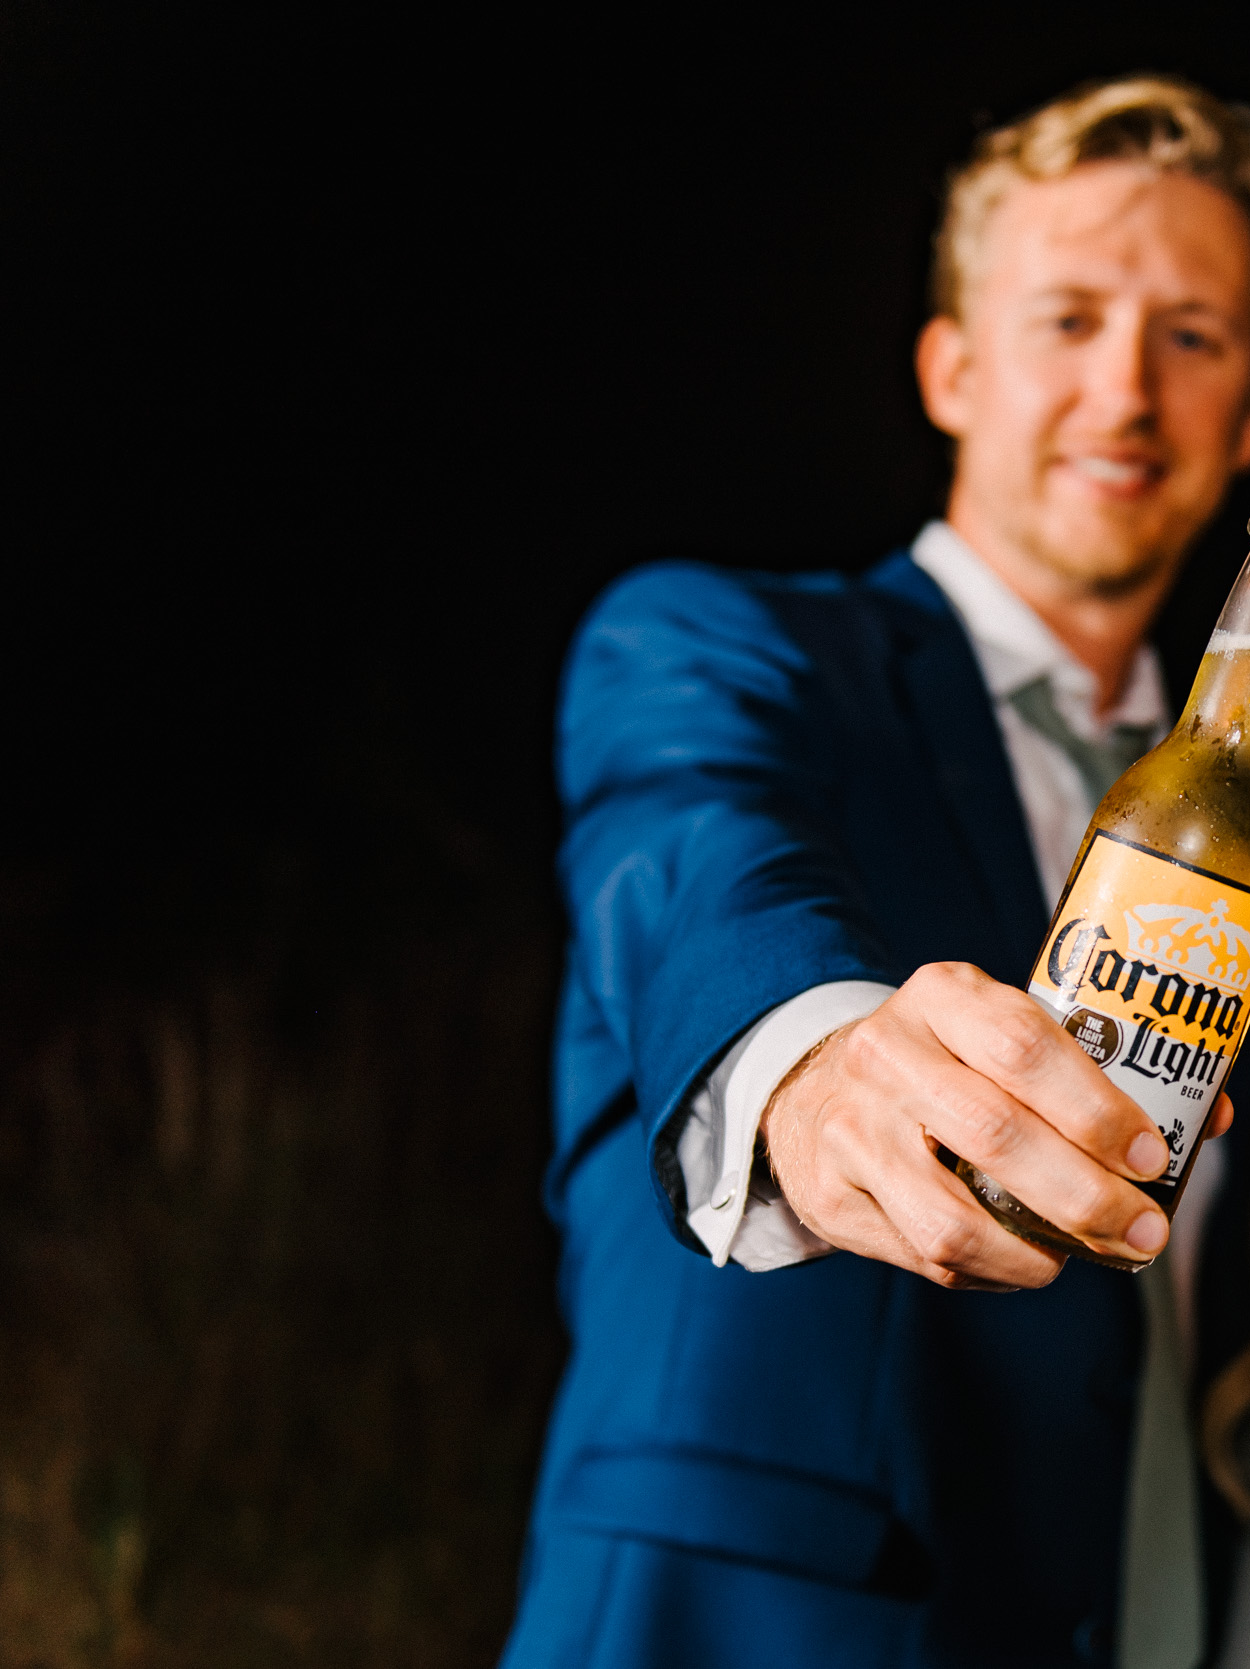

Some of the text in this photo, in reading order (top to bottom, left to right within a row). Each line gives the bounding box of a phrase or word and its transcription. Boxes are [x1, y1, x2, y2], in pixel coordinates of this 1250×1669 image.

[1047, 918, 1244, 1040] Corona
[1085, 1015, 1104, 1033] THE
[1076, 1025, 1105, 1046] LIGHT
[1120, 1012, 1226, 1086] Light
[1180, 1085, 1204, 1101] BEER
